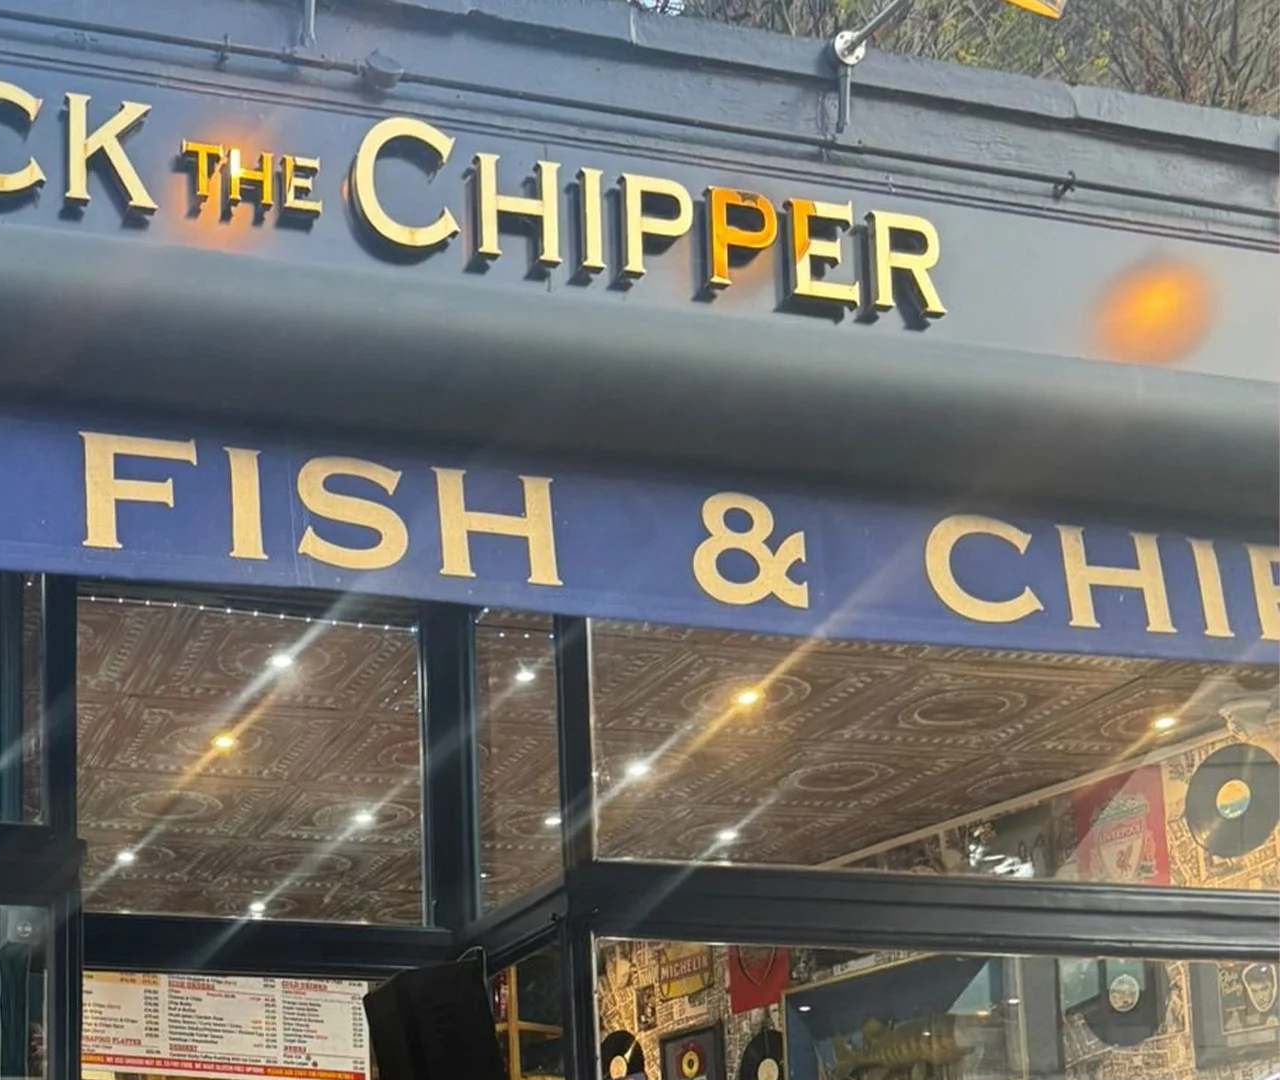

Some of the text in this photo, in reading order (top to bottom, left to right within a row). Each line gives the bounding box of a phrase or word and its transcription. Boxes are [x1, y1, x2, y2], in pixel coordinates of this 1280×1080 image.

[181, 138, 322, 218] THE
[350, 116, 948, 318] CHIPPER
[78, 430, 564, 586] FISH
[693, 491, 809, 608] &
[659, 954, 709, 980] MICHELIN
